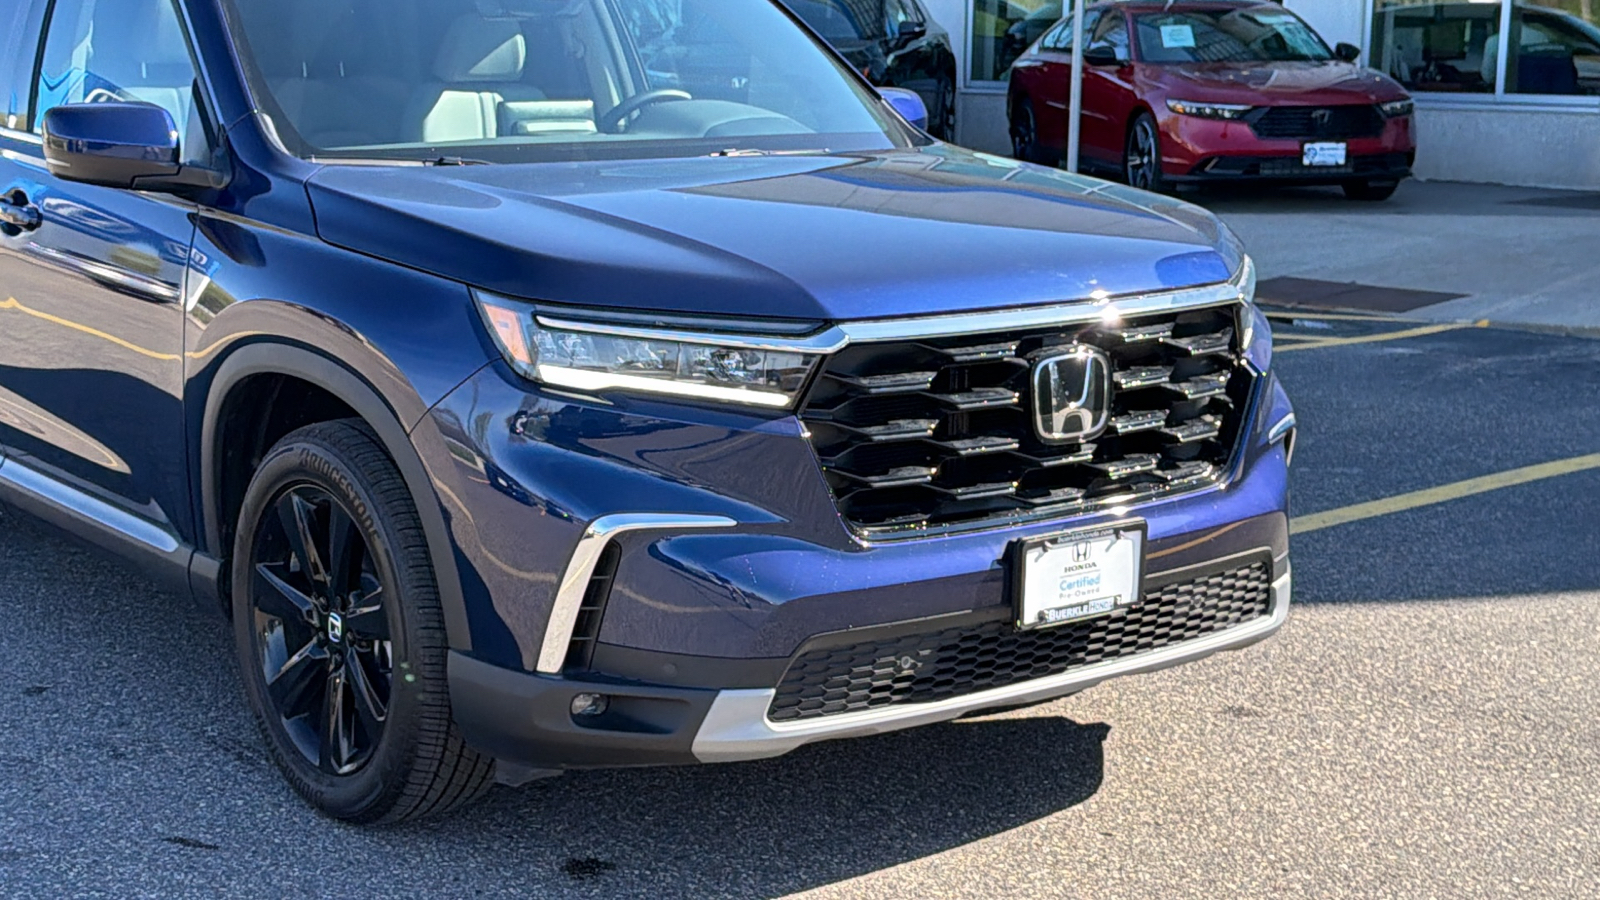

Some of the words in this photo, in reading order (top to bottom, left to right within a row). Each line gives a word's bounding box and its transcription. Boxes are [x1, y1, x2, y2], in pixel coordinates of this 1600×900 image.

[1064, 562, 1097, 573] HONDA
[1060, 573, 1101, 591] Certified
[1059, 587, 1100, 599] Pre-Owned
[1047, 605, 1089, 621] BUERKLE
